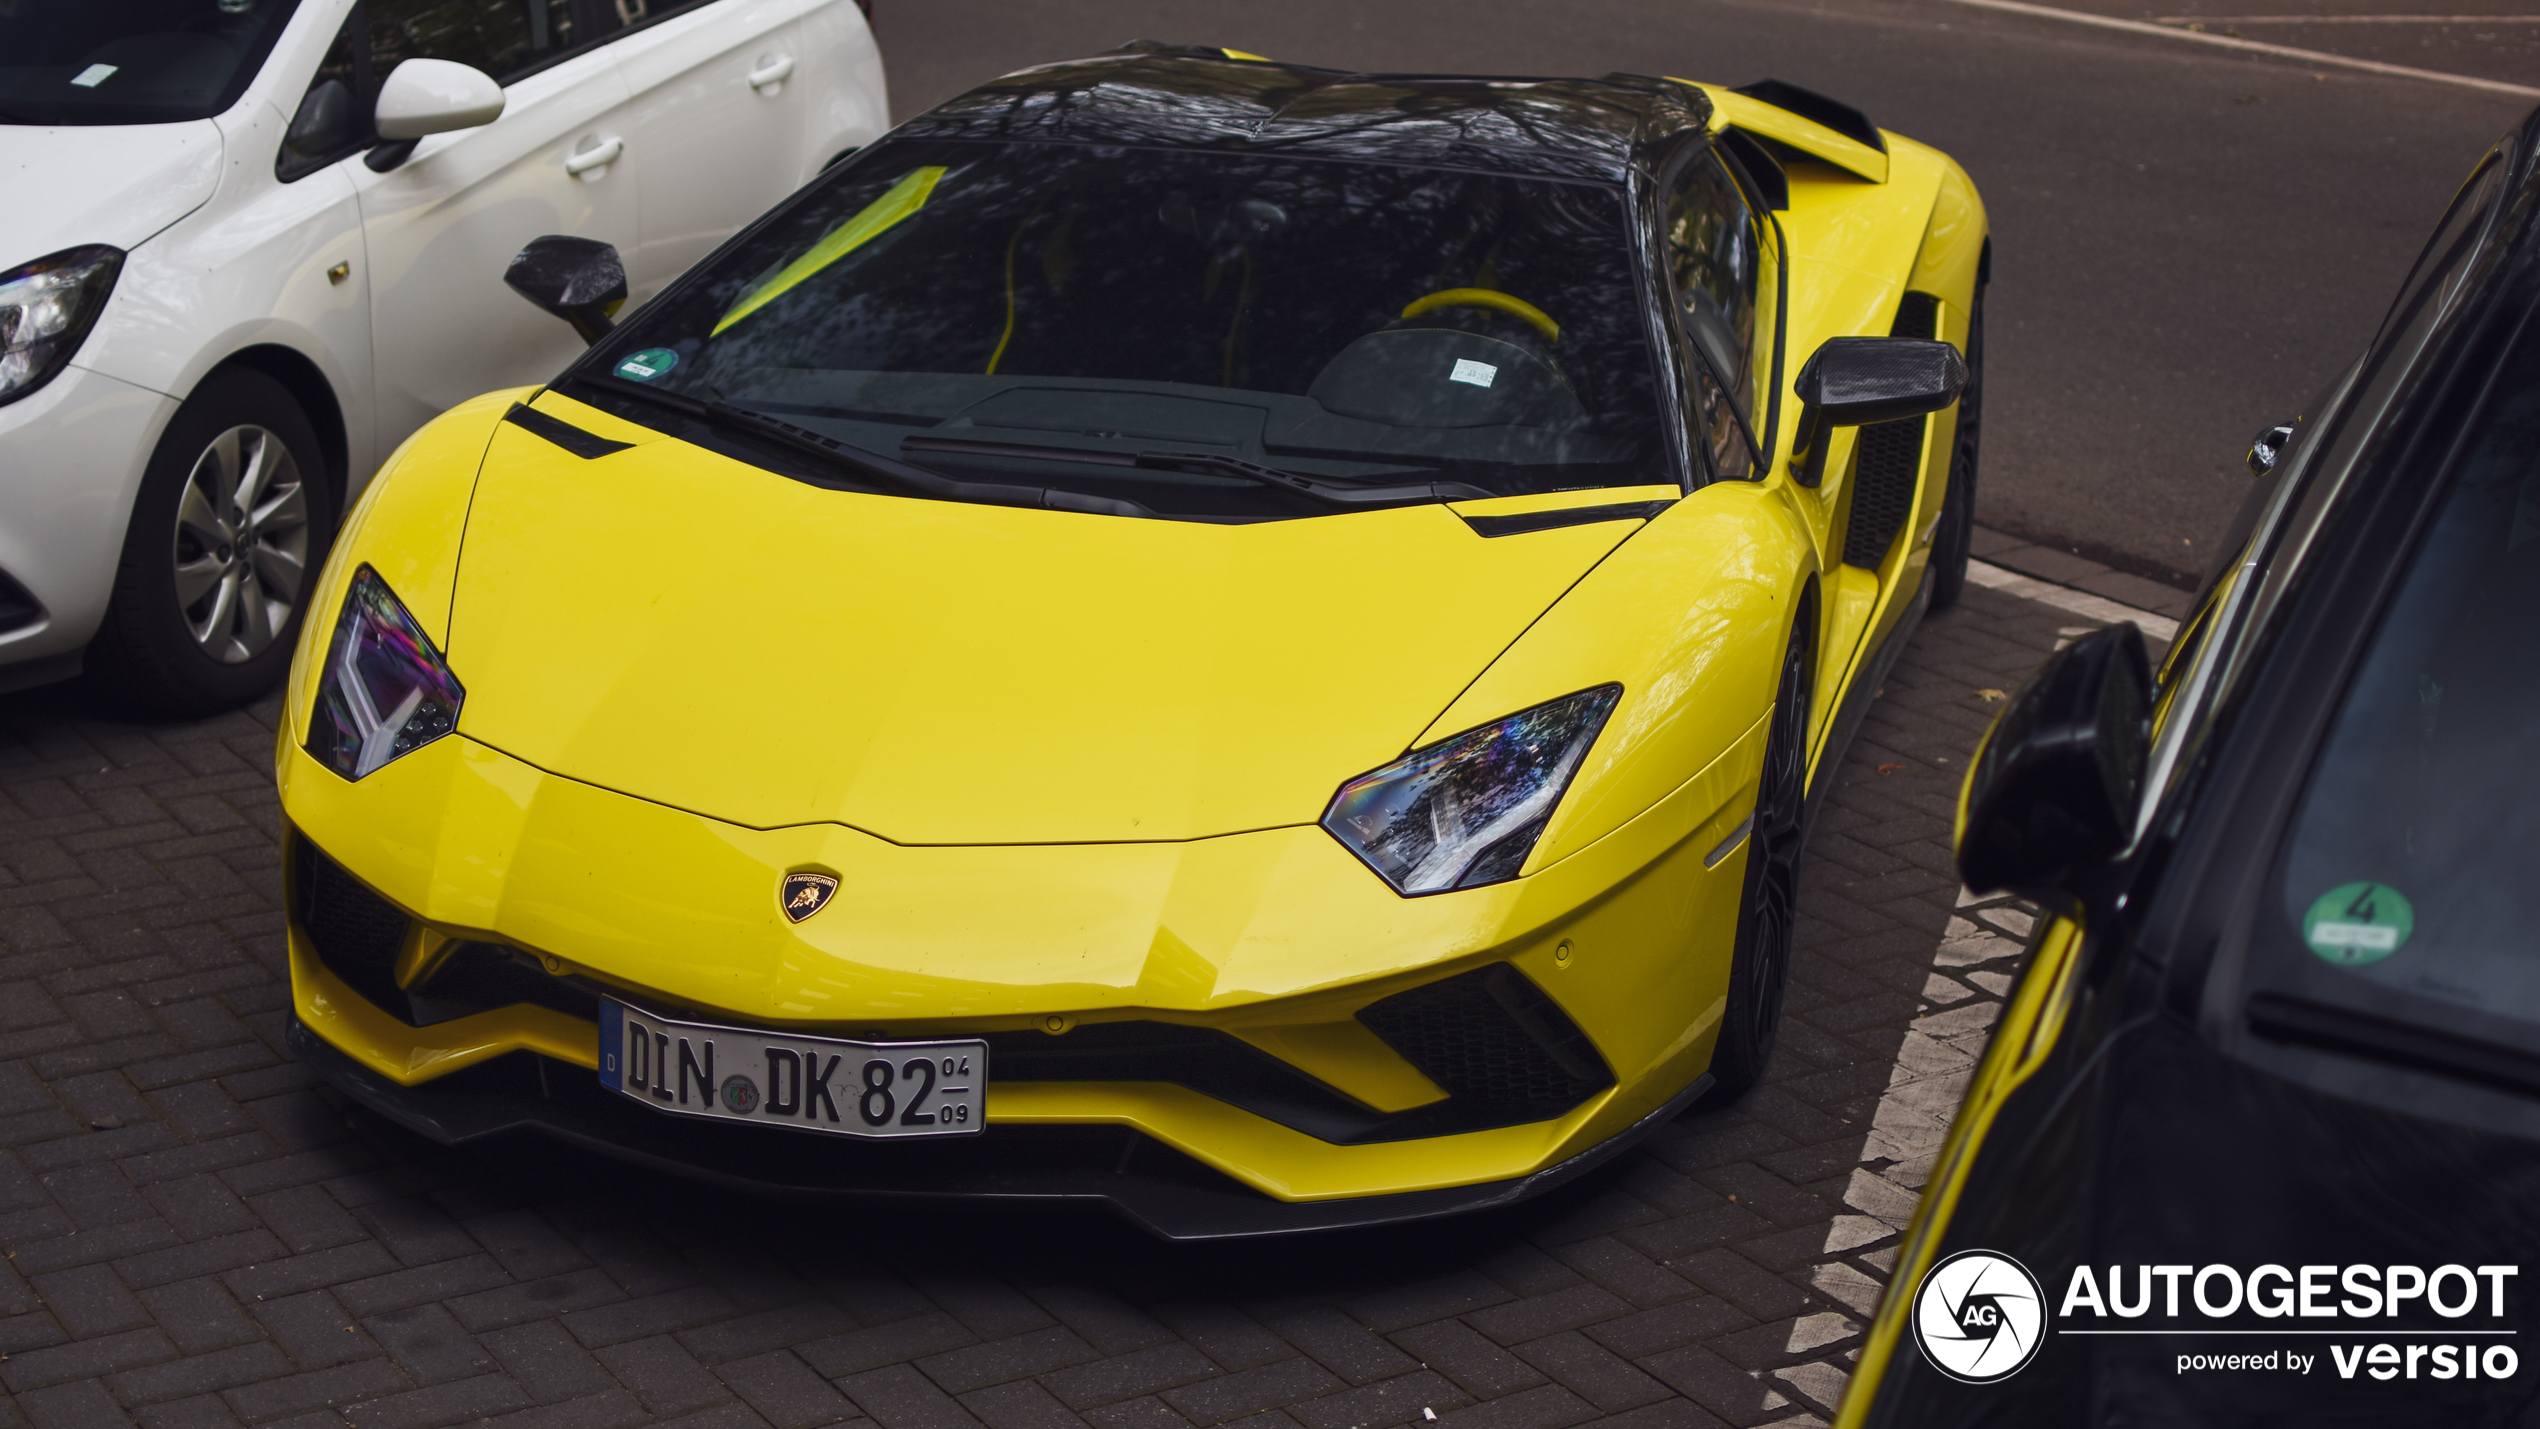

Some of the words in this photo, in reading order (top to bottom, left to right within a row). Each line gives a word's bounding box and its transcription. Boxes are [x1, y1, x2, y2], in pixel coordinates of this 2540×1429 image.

[788, 875, 835, 888] LAMBORGHINI
[2345, 882, 2376, 924] 4
[607, 1053, 615, 1072] D
[942, 1056, 970, 1076] 04
[629, 1020, 714, 1107] DIN
[765, 1046, 841, 1122] DK
[860, 1058, 936, 1126] 82
[941, 1104, 968, 1124] 09
